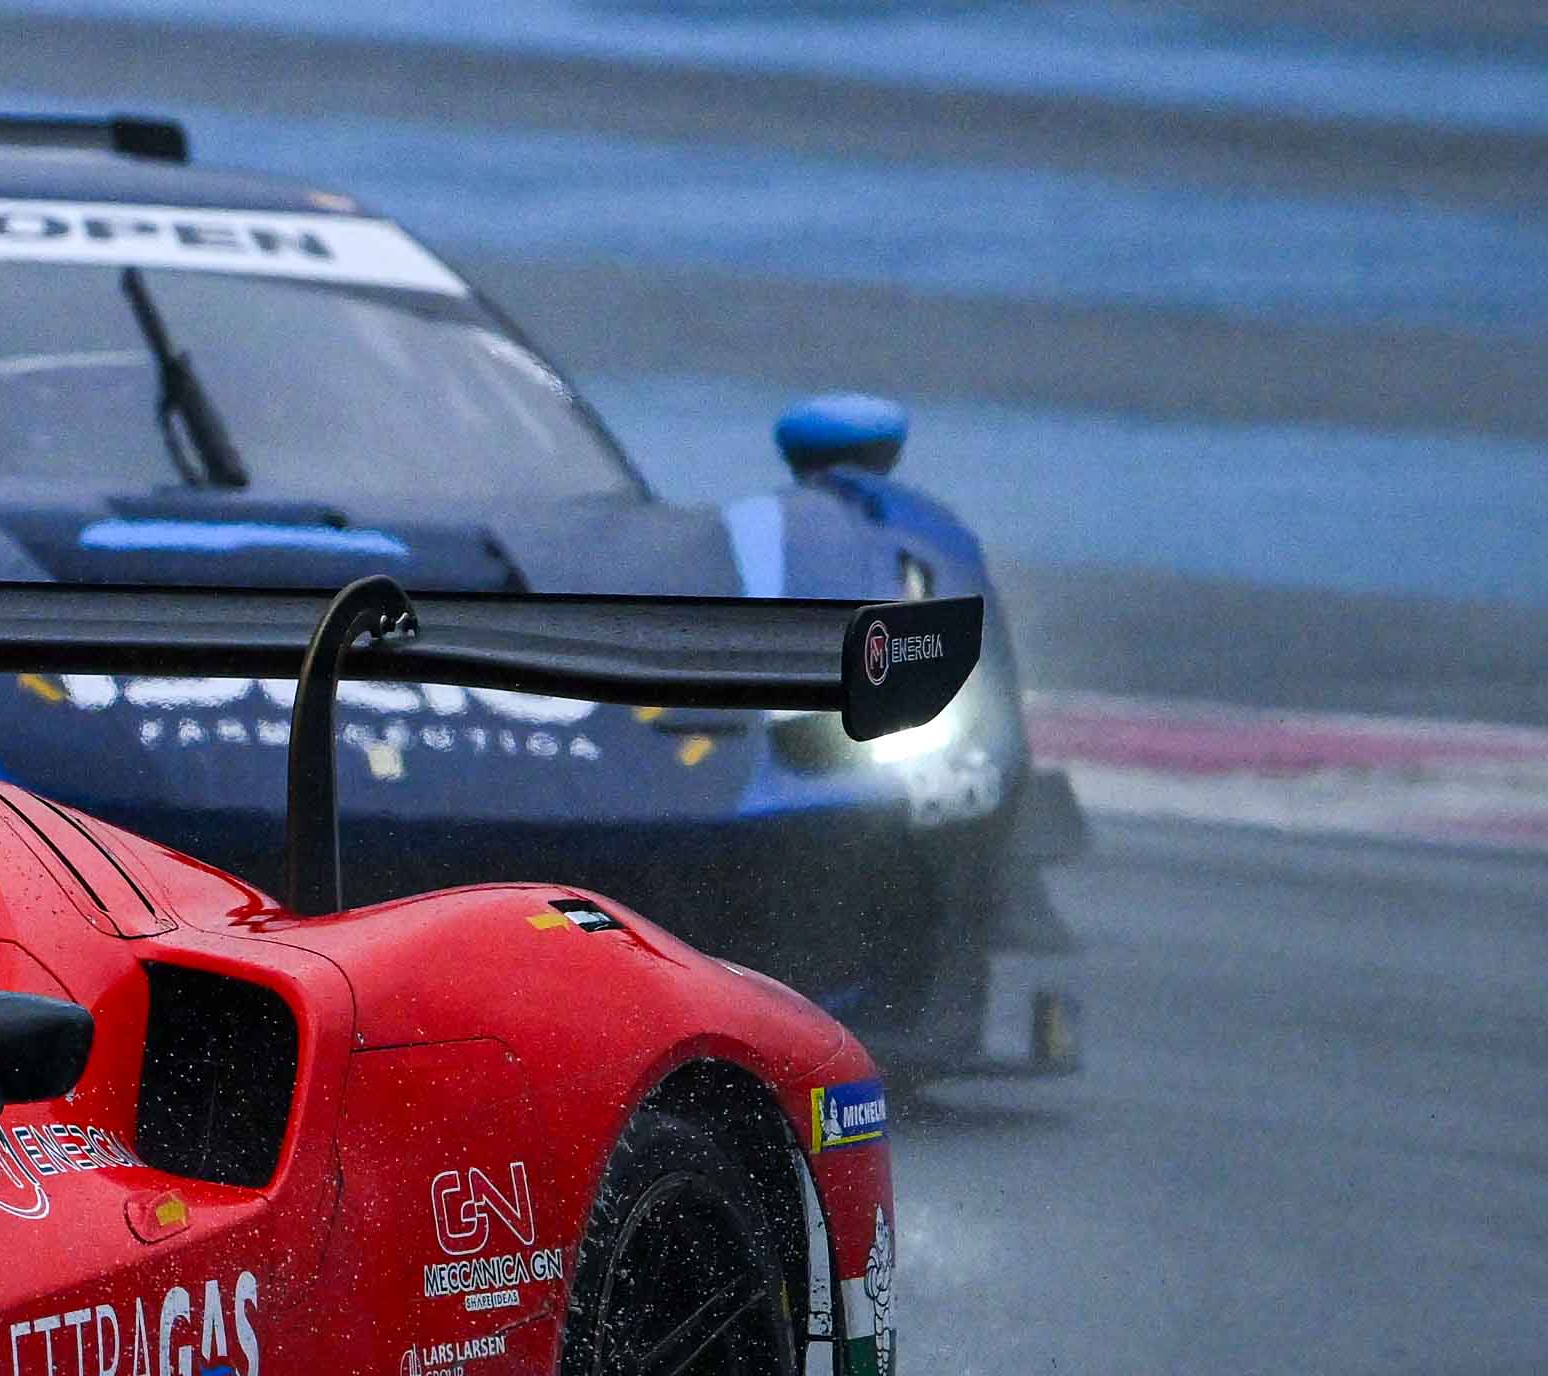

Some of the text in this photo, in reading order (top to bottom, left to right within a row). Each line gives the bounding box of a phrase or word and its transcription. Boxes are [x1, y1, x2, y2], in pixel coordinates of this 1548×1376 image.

[423, 1248, 564, 1297] MECCANICA GN
[464, 1288, 519, 1312] SHAPE IDEAS
[422, 1334, 507, 1367] LARS LARSEN
